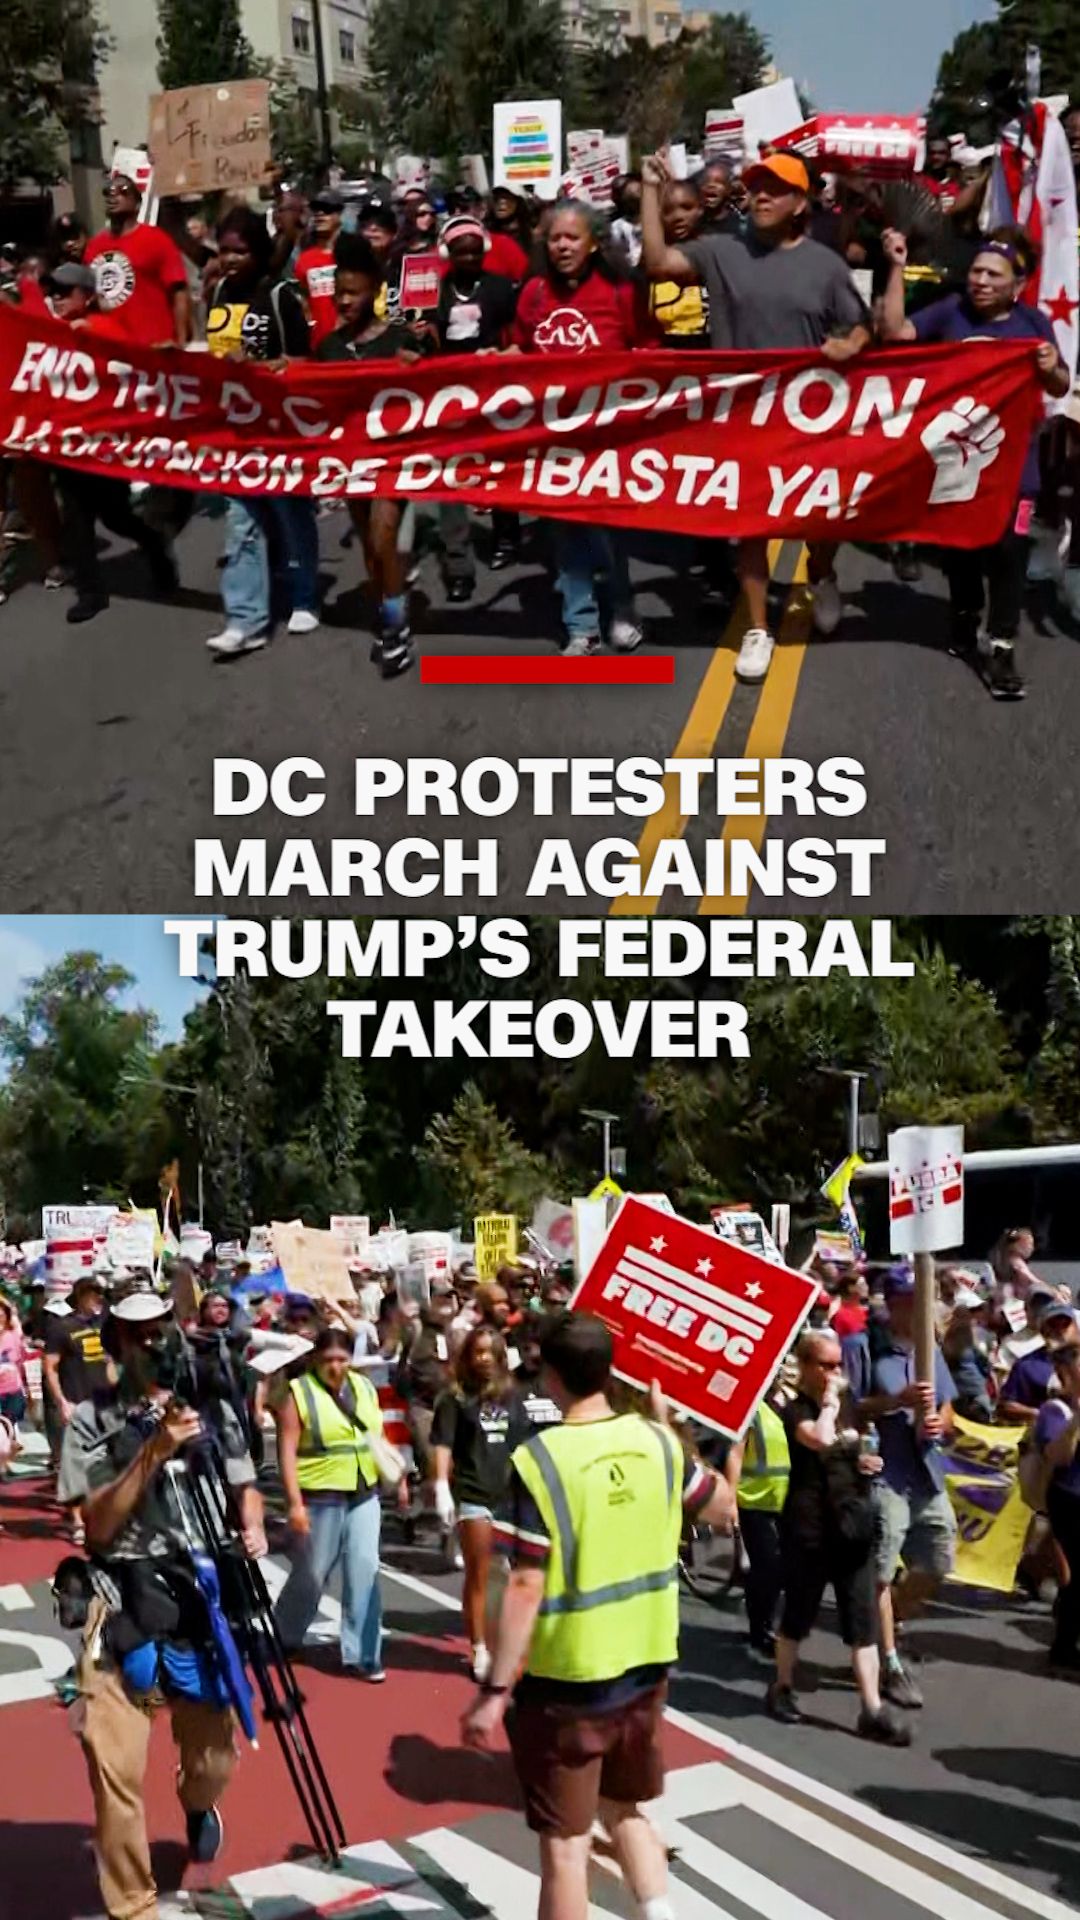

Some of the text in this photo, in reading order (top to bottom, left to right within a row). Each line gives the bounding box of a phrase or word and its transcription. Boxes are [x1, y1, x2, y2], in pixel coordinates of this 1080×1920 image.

[533, 319, 601, 347] CASA
[10, 341, 101, 402] END
[106, 359, 201, 421] THE
[365, 366, 927, 441] OCCUPATION
[0, 415, 54, 454] LA
[309, 456, 389, 496] DE
[393, 452, 506, 491] DC:
[766, 463, 875, 521] YA!
[601, 1273, 699, 1339] FREE
[695, 1319, 755, 1367] DC
